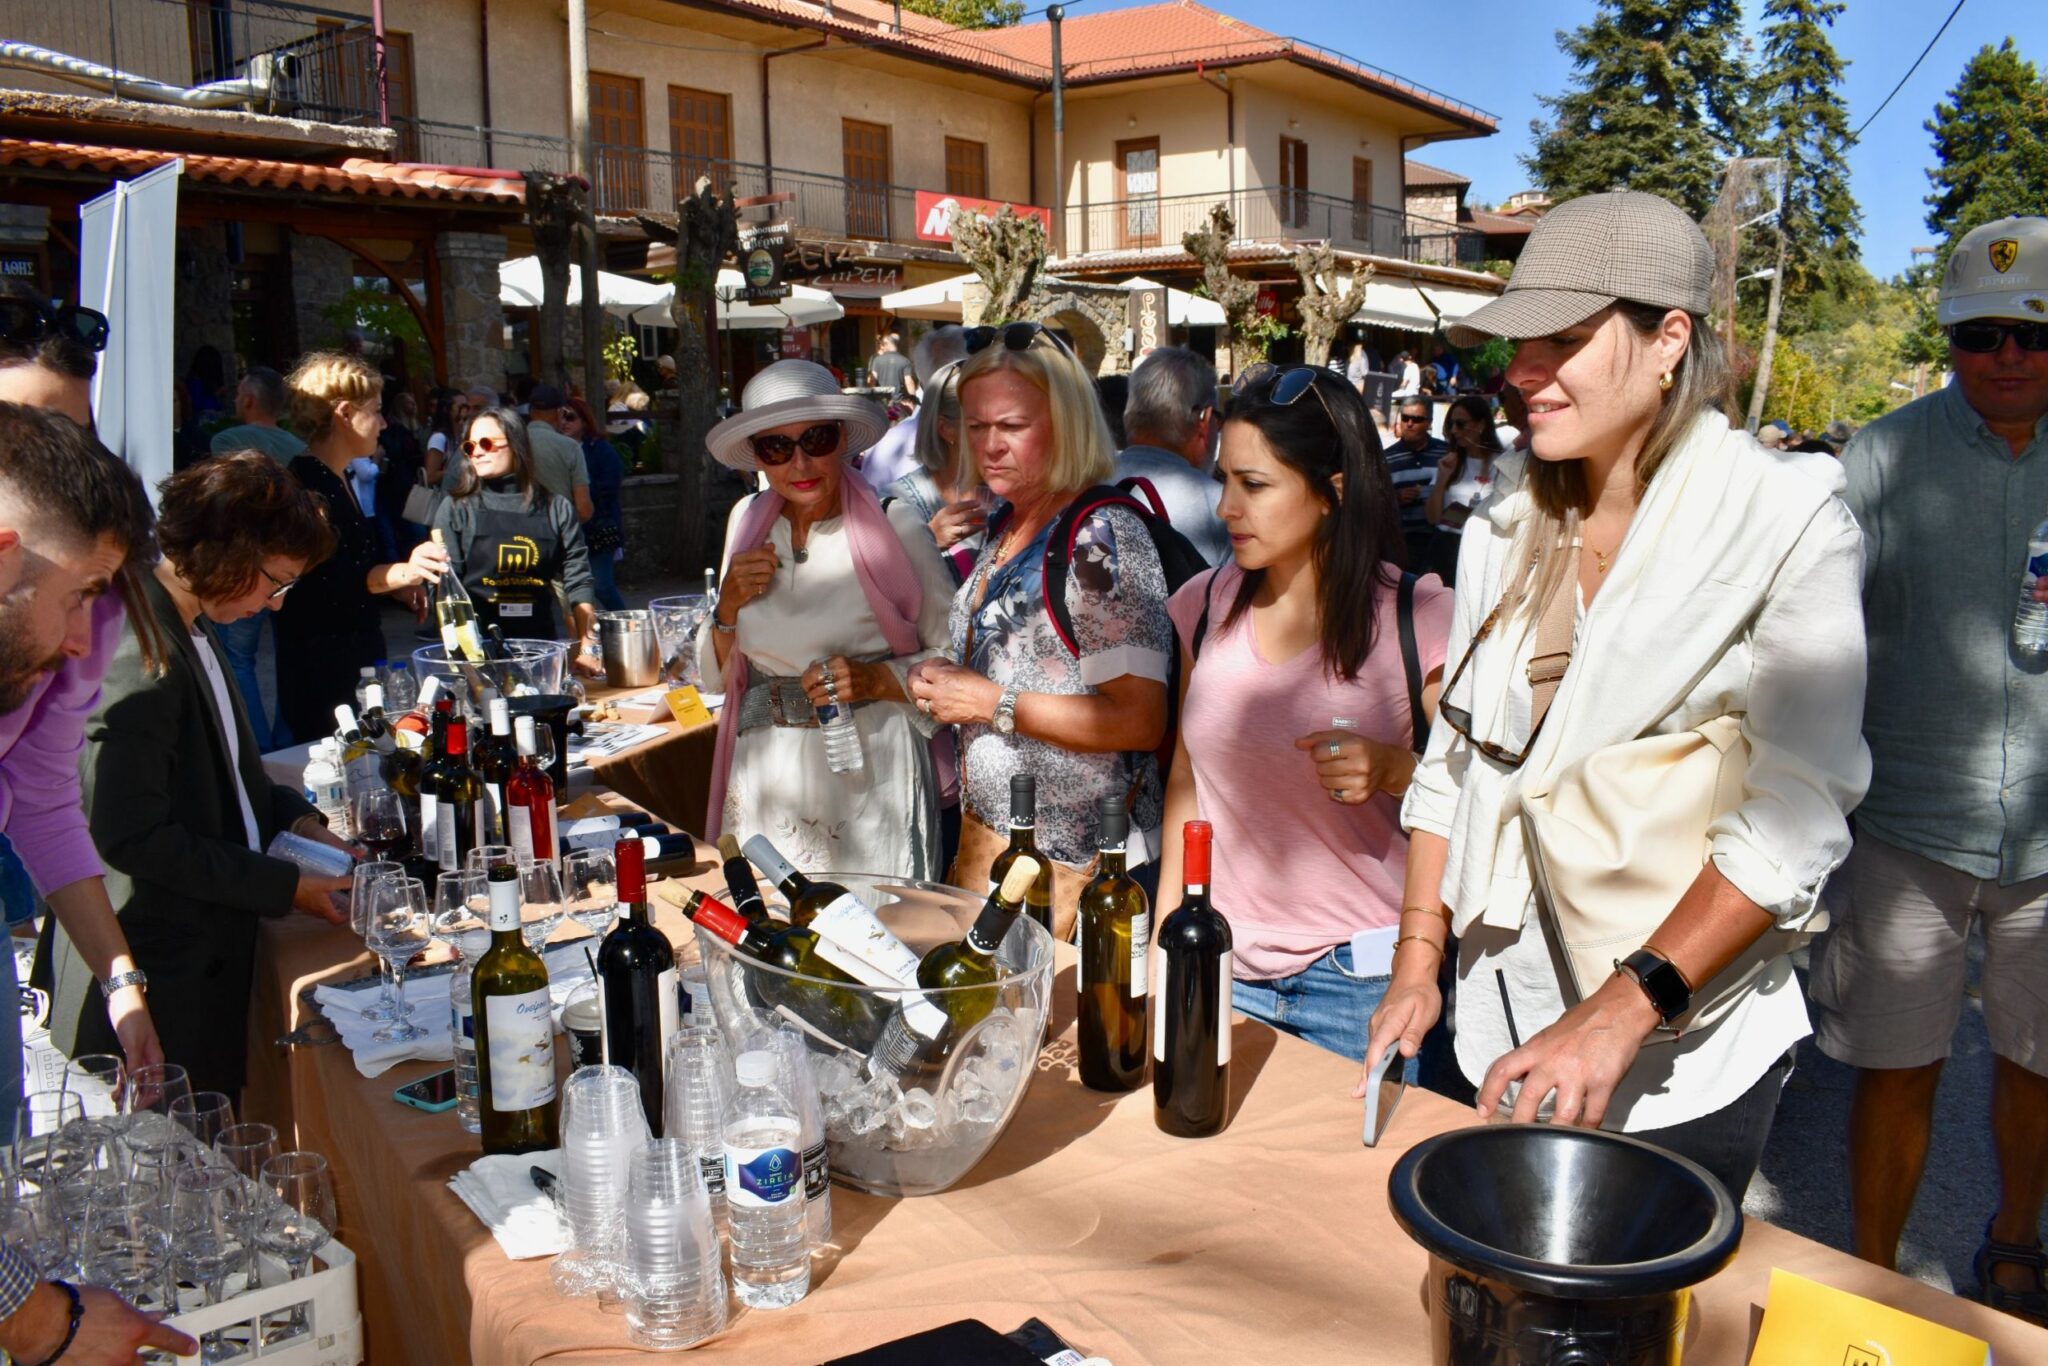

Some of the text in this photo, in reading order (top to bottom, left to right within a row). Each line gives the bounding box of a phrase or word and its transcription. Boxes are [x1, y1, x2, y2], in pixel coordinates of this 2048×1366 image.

[0, 261, 35, 276] ΑΘΗΣ
[482, 577, 510, 587] Food
[756, 1172, 794, 1186] ZIREIA
